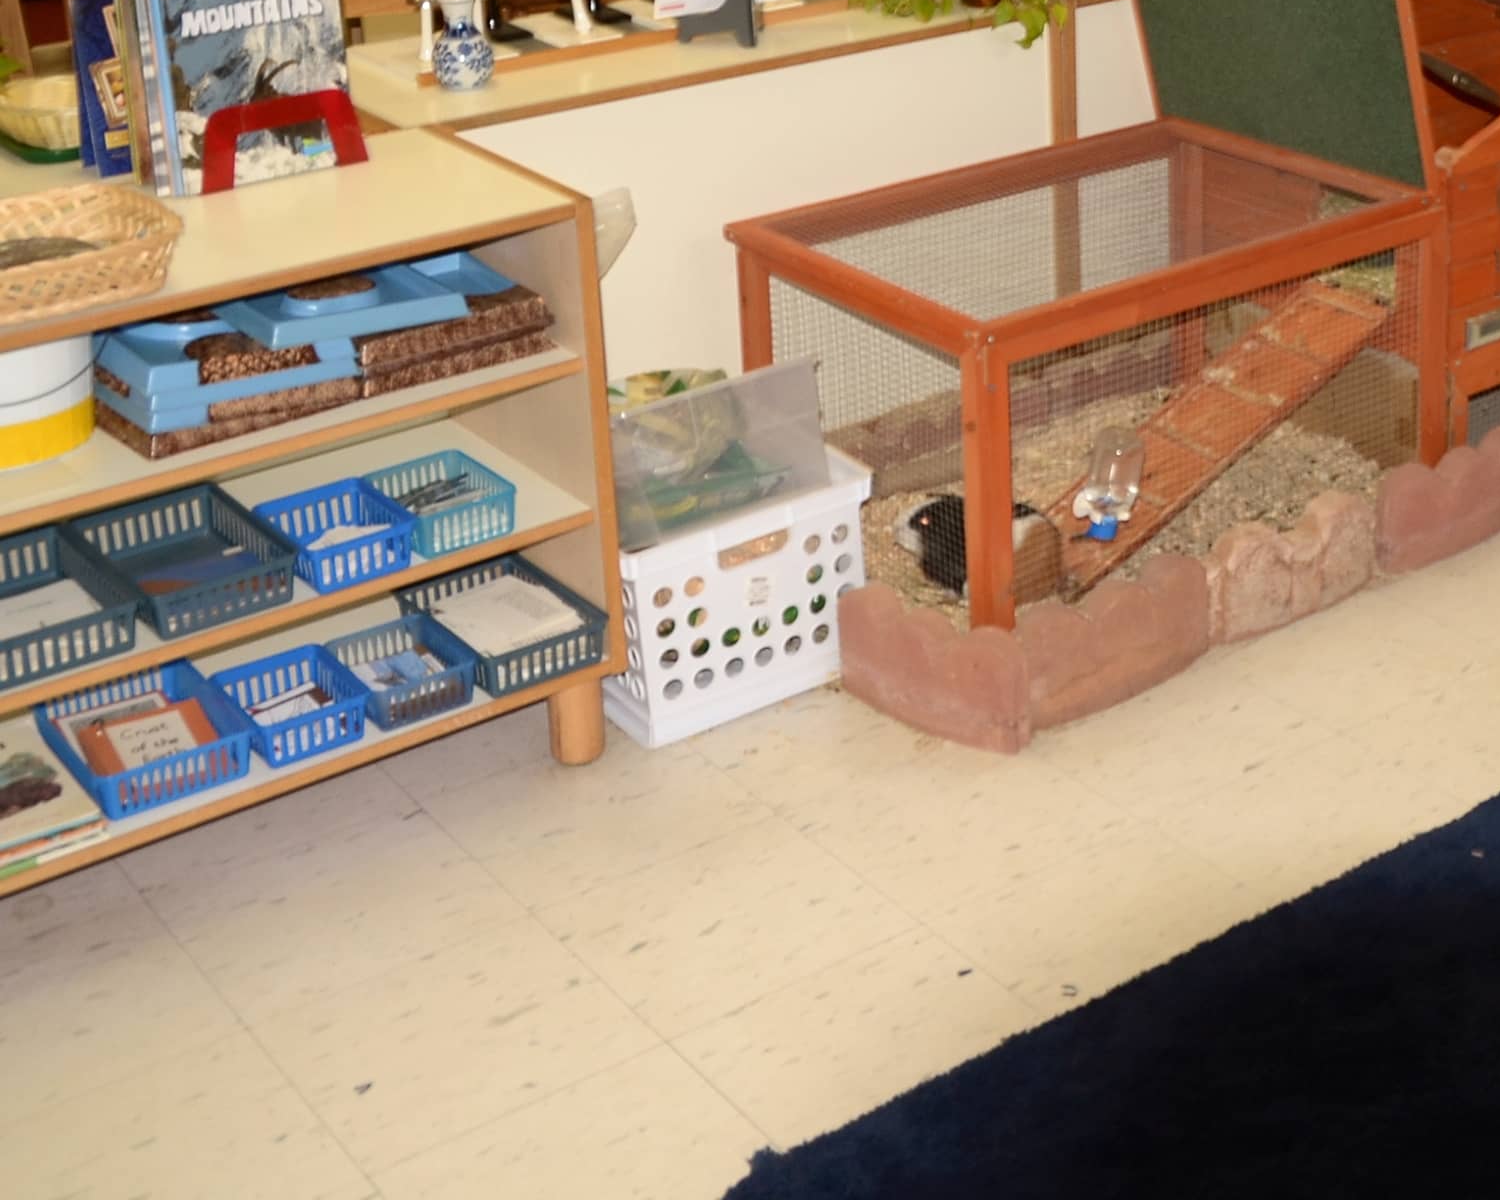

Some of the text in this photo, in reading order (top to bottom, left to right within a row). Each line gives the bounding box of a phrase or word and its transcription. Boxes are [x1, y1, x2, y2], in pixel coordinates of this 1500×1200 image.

[120, 722, 168, 739] Crust
[131, 737, 179, 754] of the
